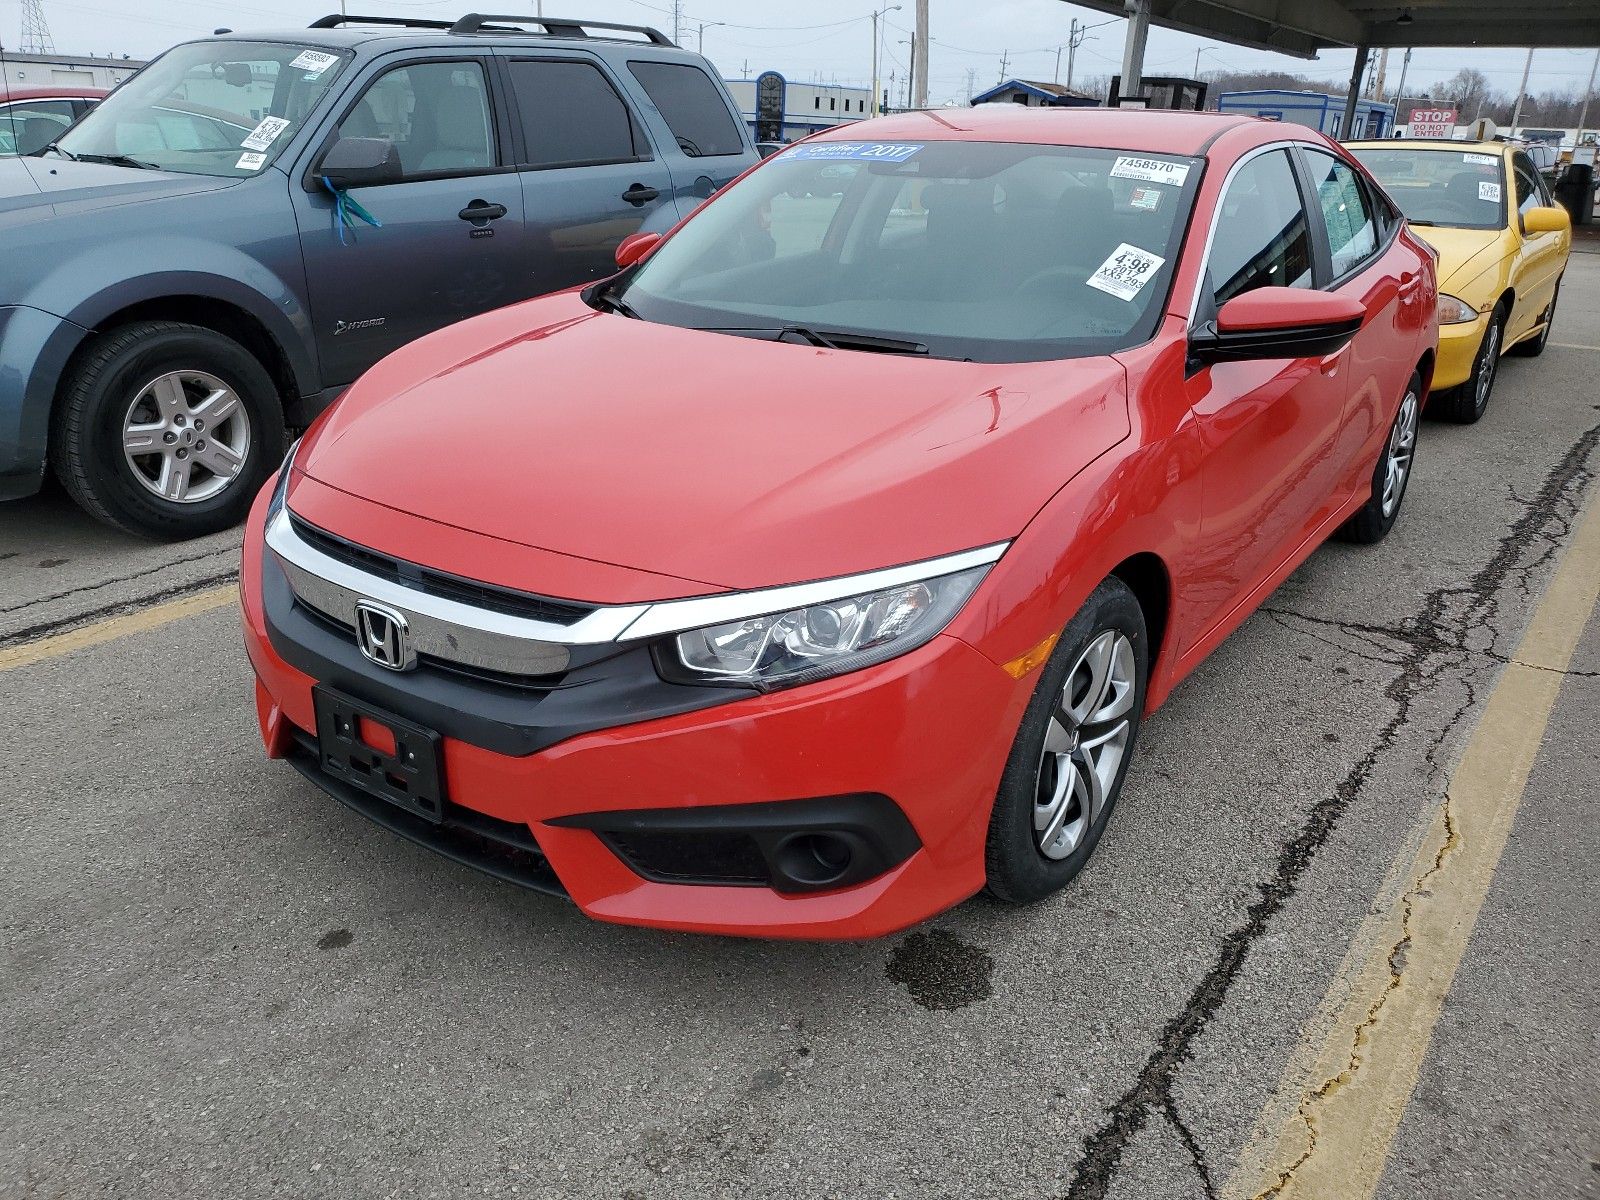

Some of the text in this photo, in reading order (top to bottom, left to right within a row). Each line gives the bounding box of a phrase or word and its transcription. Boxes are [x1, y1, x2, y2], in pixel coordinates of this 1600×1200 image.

[1413, 111, 1452, 122] STOP
[810, 144, 918, 157] Certified 2017
[1119, 158, 1174, 173] 7458570
[1100, 266, 1145, 289] XX5.293
[1113, 264, 1141, 278] 2017
[347, 317, 386, 330] HYBRID
